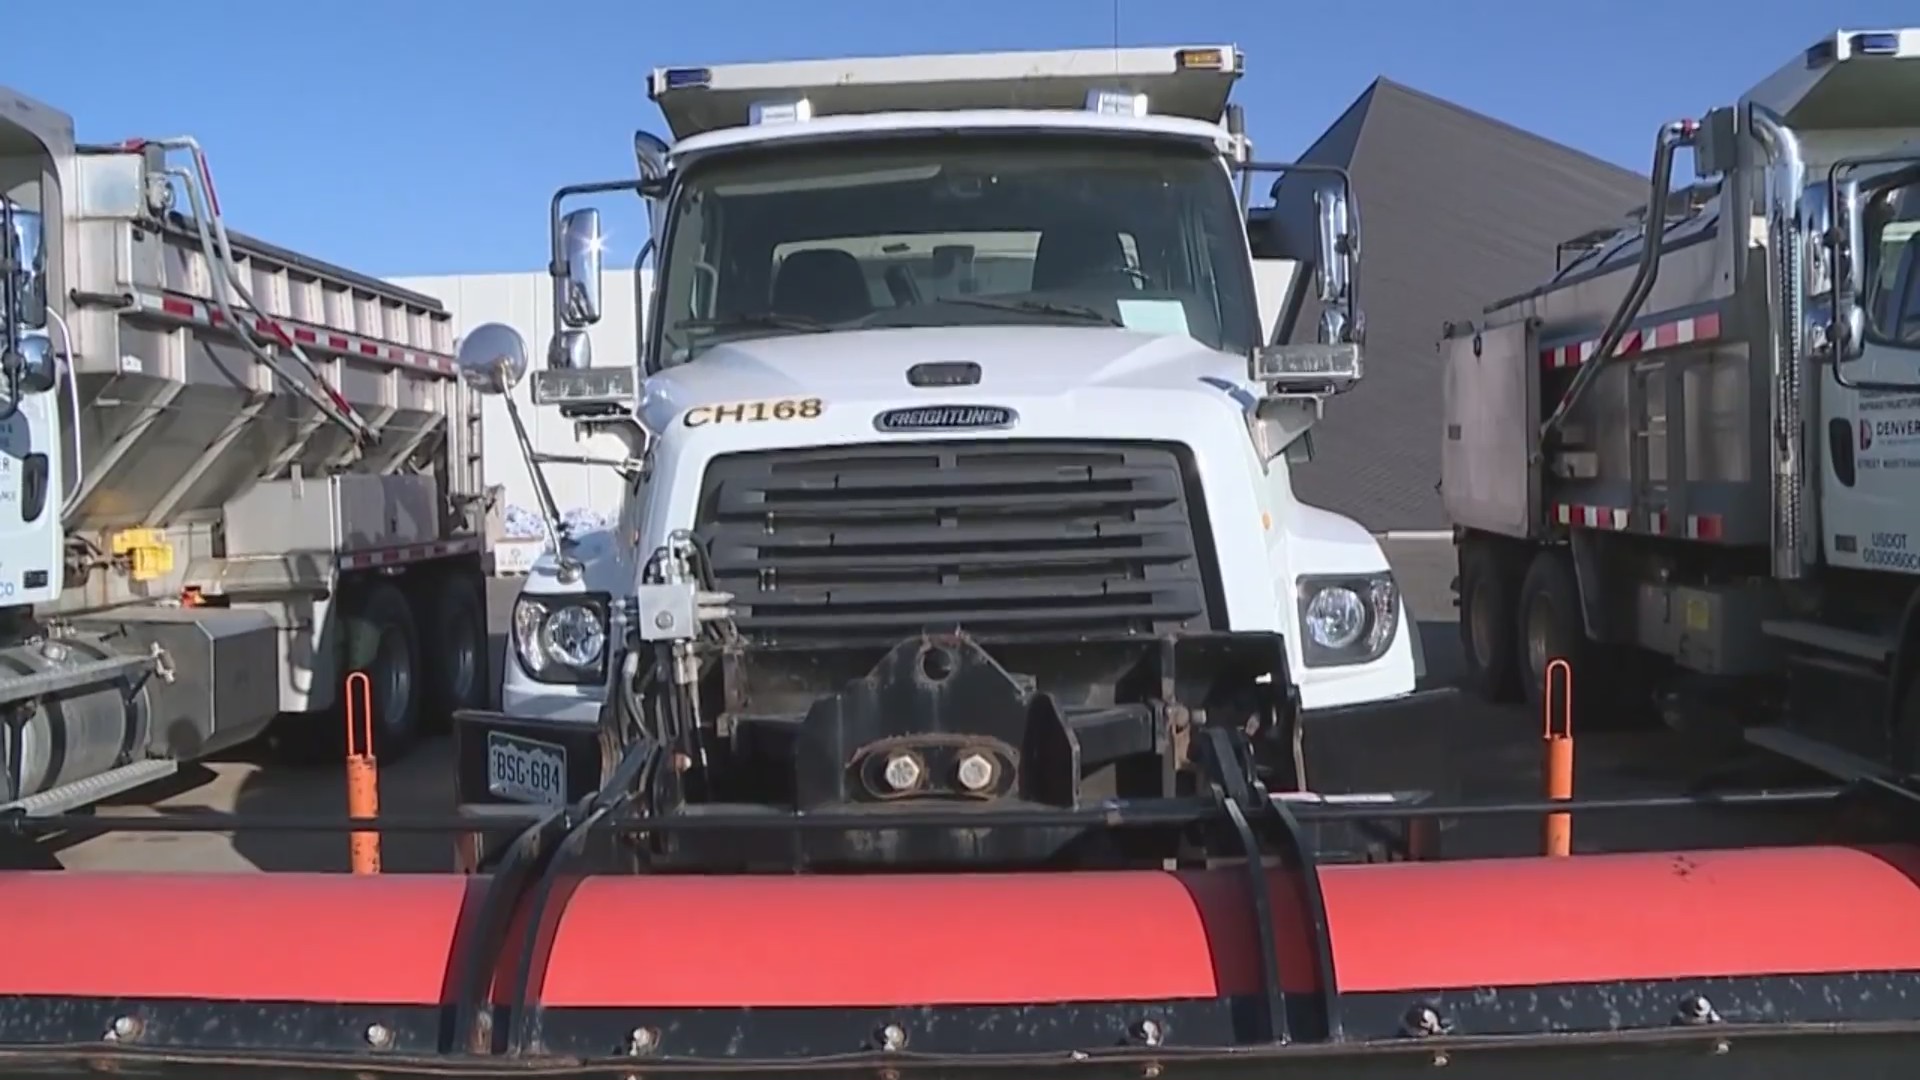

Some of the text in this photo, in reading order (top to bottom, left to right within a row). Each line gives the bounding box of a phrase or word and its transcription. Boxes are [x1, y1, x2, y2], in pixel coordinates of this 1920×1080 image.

[682, 397, 823, 429] CH168
[888, 408, 1005, 426] FREIGHTLINER
[1876, 418, 1920, 436] DENVER
[1871, 531, 1907, 549] USDOT
